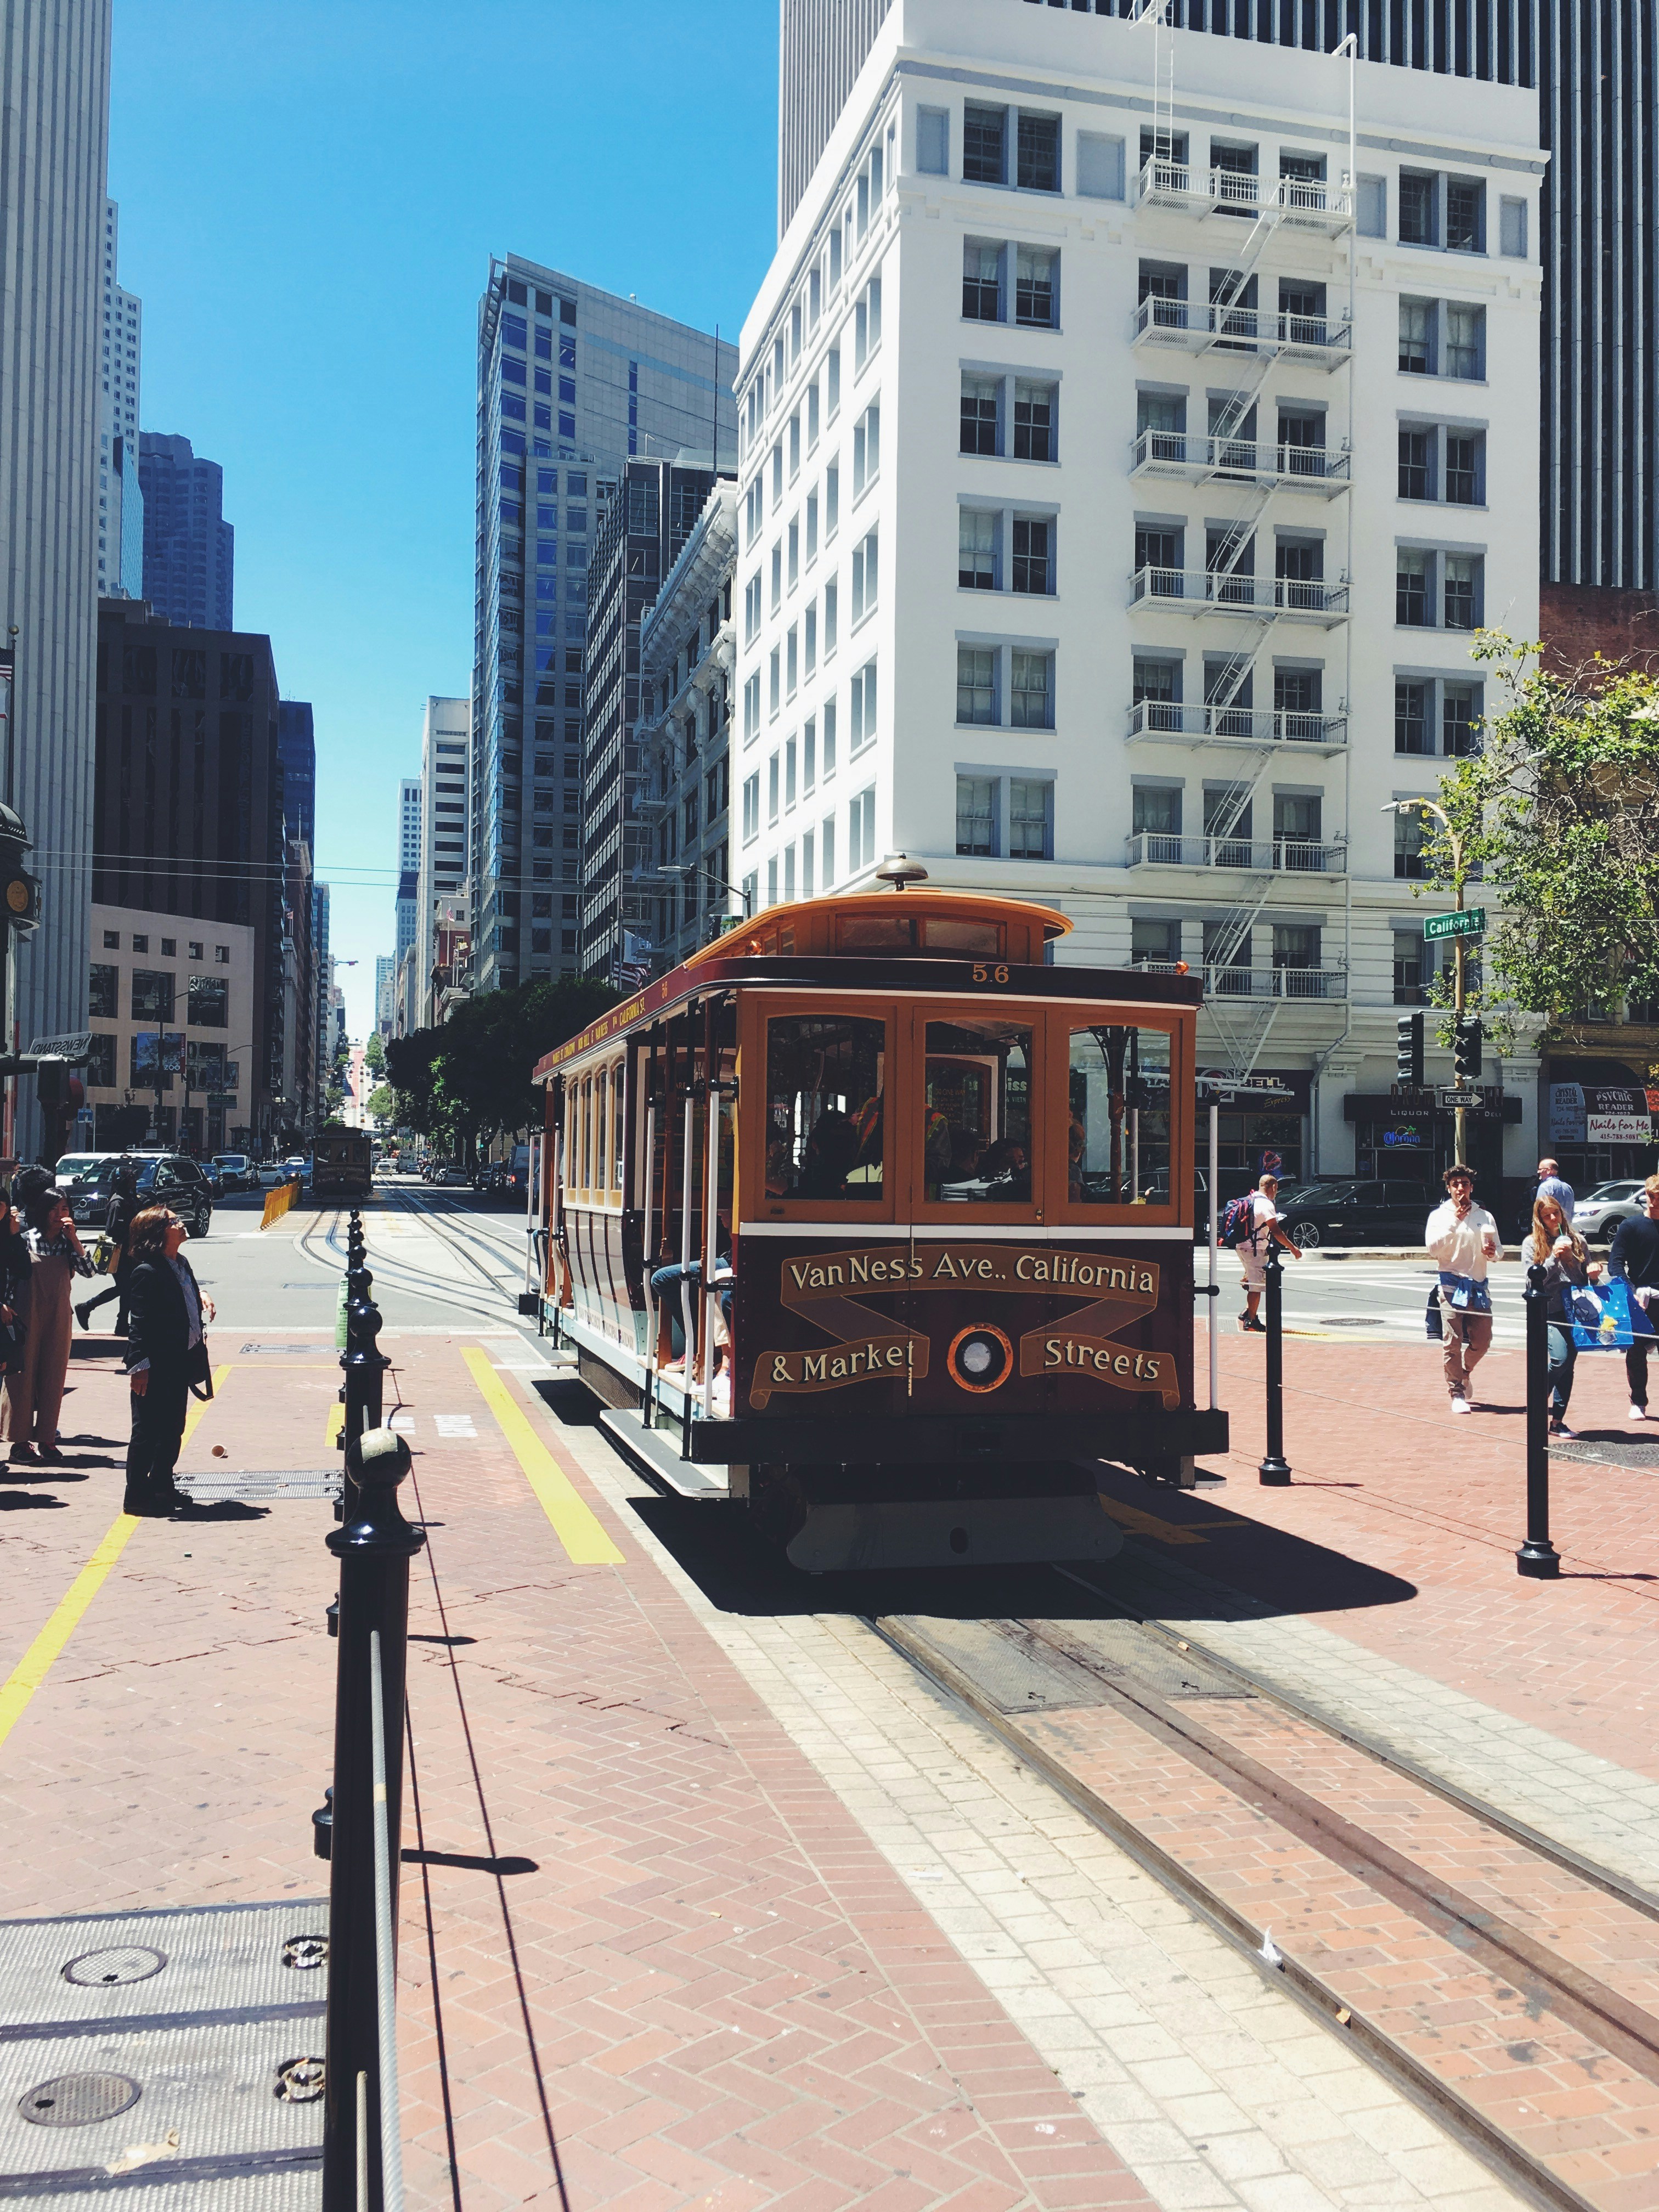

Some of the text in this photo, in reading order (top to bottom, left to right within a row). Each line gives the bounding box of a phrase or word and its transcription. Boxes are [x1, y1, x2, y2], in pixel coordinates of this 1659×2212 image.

[973, 963, 1009, 983] 56
[1596, 1090, 1633, 1102] PSYCHIC
[1590, 1118, 1649, 1131] Nails For Me
[1384, 1131, 1420, 1144] Corona
[789, 1263, 844, 1291] Van
[848, 1254, 923, 1283] Ness
[1015, 1255, 1155, 1294] California
[771, 1340, 915, 1383] & Market
[1043, 1339, 1161, 1381] Streets
